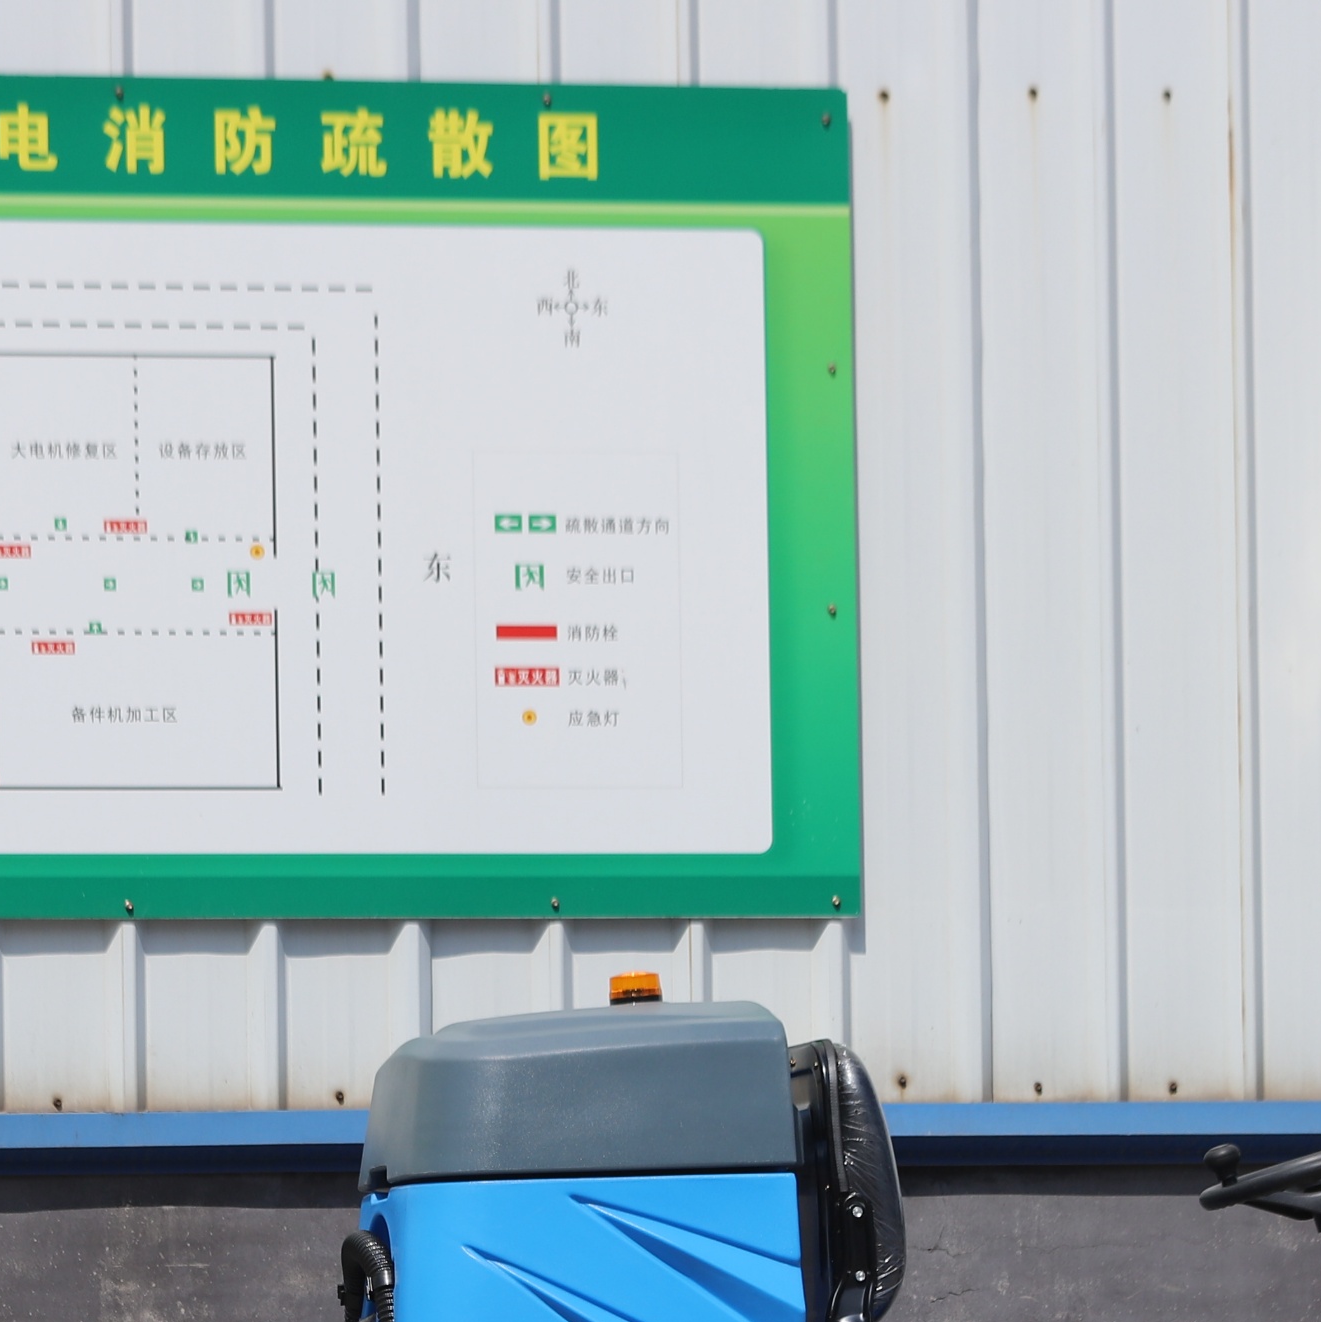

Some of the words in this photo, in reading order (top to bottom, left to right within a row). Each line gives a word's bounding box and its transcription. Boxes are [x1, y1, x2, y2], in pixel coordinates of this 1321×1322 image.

[563, 267, 580, 289] 北
[537, 297, 553, 317] 西
[563, 328, 580, 348] 南
[159, 441, 246, 461] 设备存放区
[565, 516, 670, 535] 疏散通道方向
[424, 551, 452, 583] 东
[567, 566, 635, 585] 安全出口
[568, 624, 619, 643] 消防栓
[569, 709, 620, 728] 应急灯
